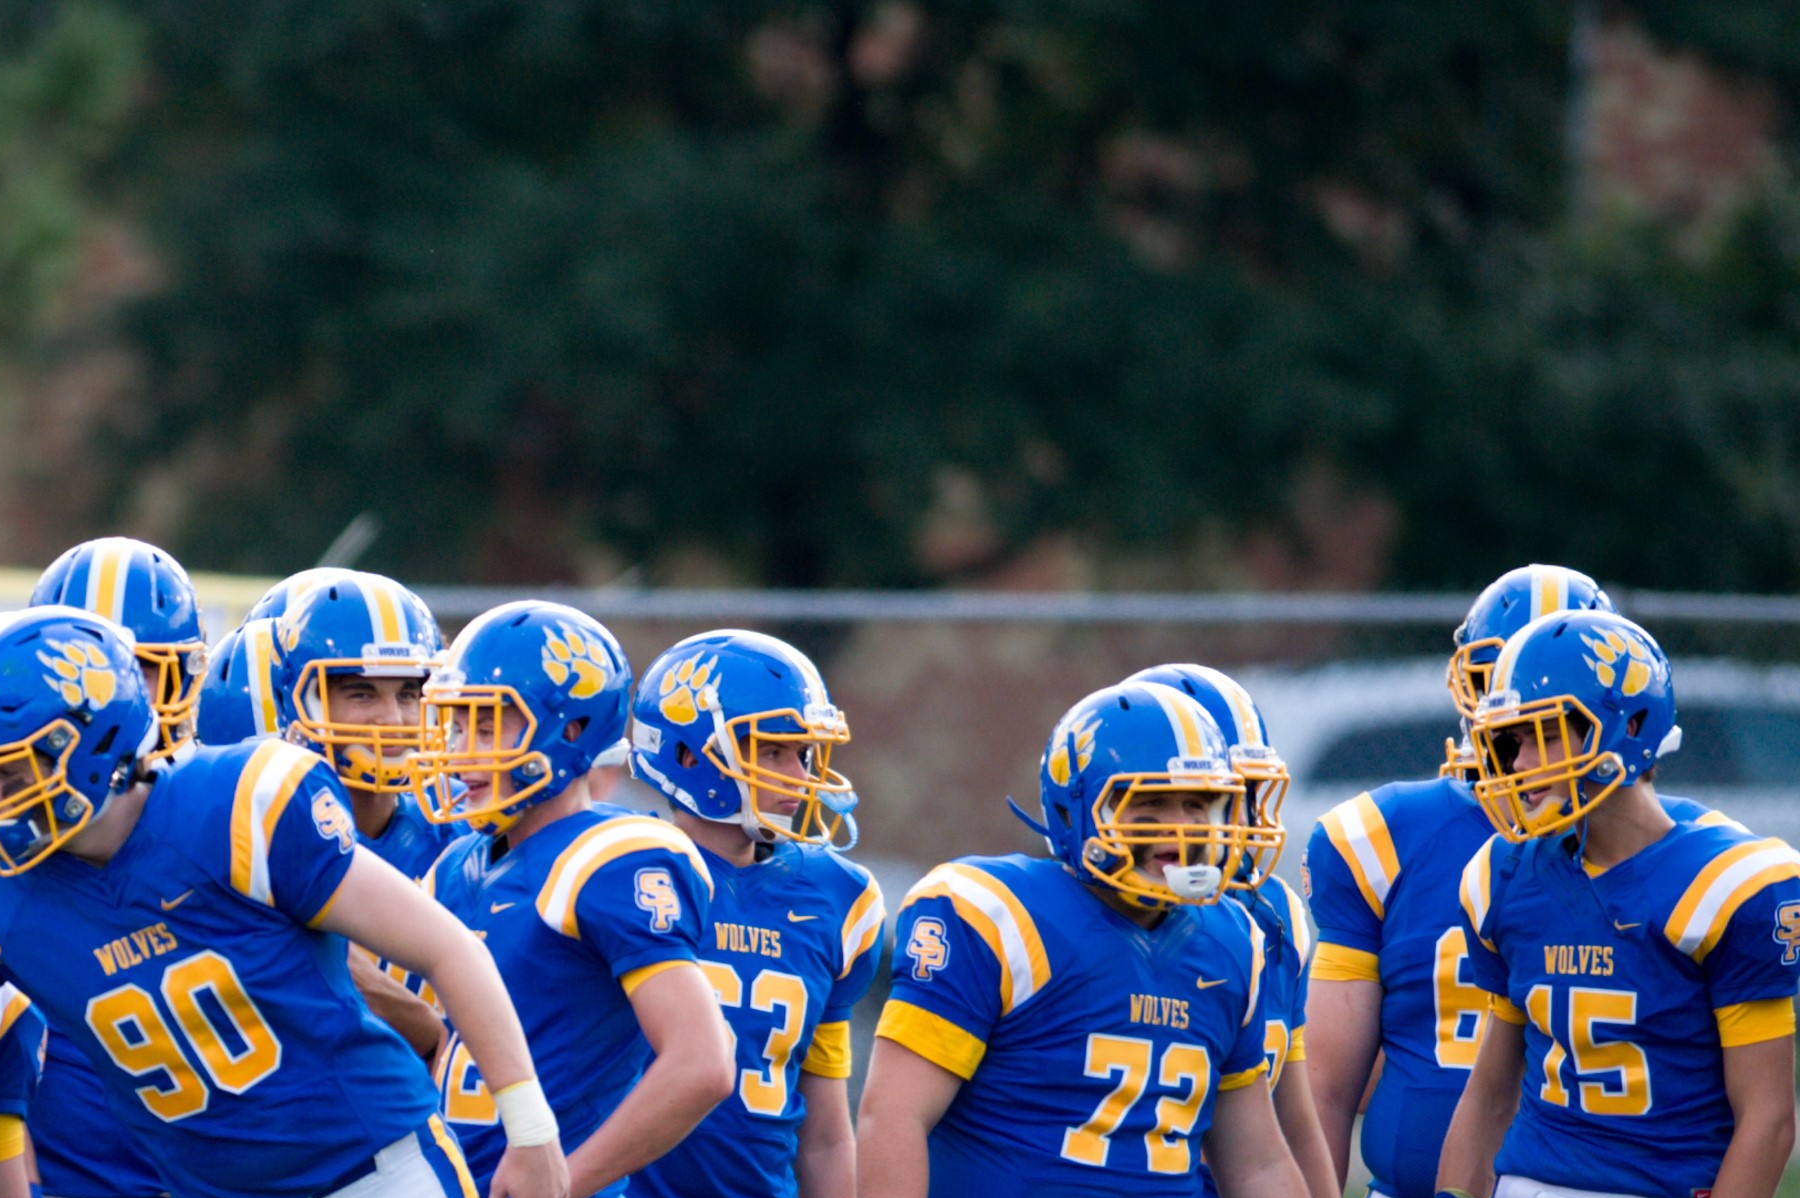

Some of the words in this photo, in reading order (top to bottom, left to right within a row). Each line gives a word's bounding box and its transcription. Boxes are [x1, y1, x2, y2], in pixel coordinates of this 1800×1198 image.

[378, 646, 411, 657] WOLVES
[1183, 760, 1213, 770] WOLVES
[93, 922, 179, 977] WOLVES
[714, 922, 783, 959] WOLVES
[1544, 945, 1615, 977] WOLVES
[1130, 994, 1190, 1030] WOLVES
[85, 949, 282, 1123] 90
[1525, 984, 1653, 1116] 15
[1061, 1033, 1212, 1175] 72
